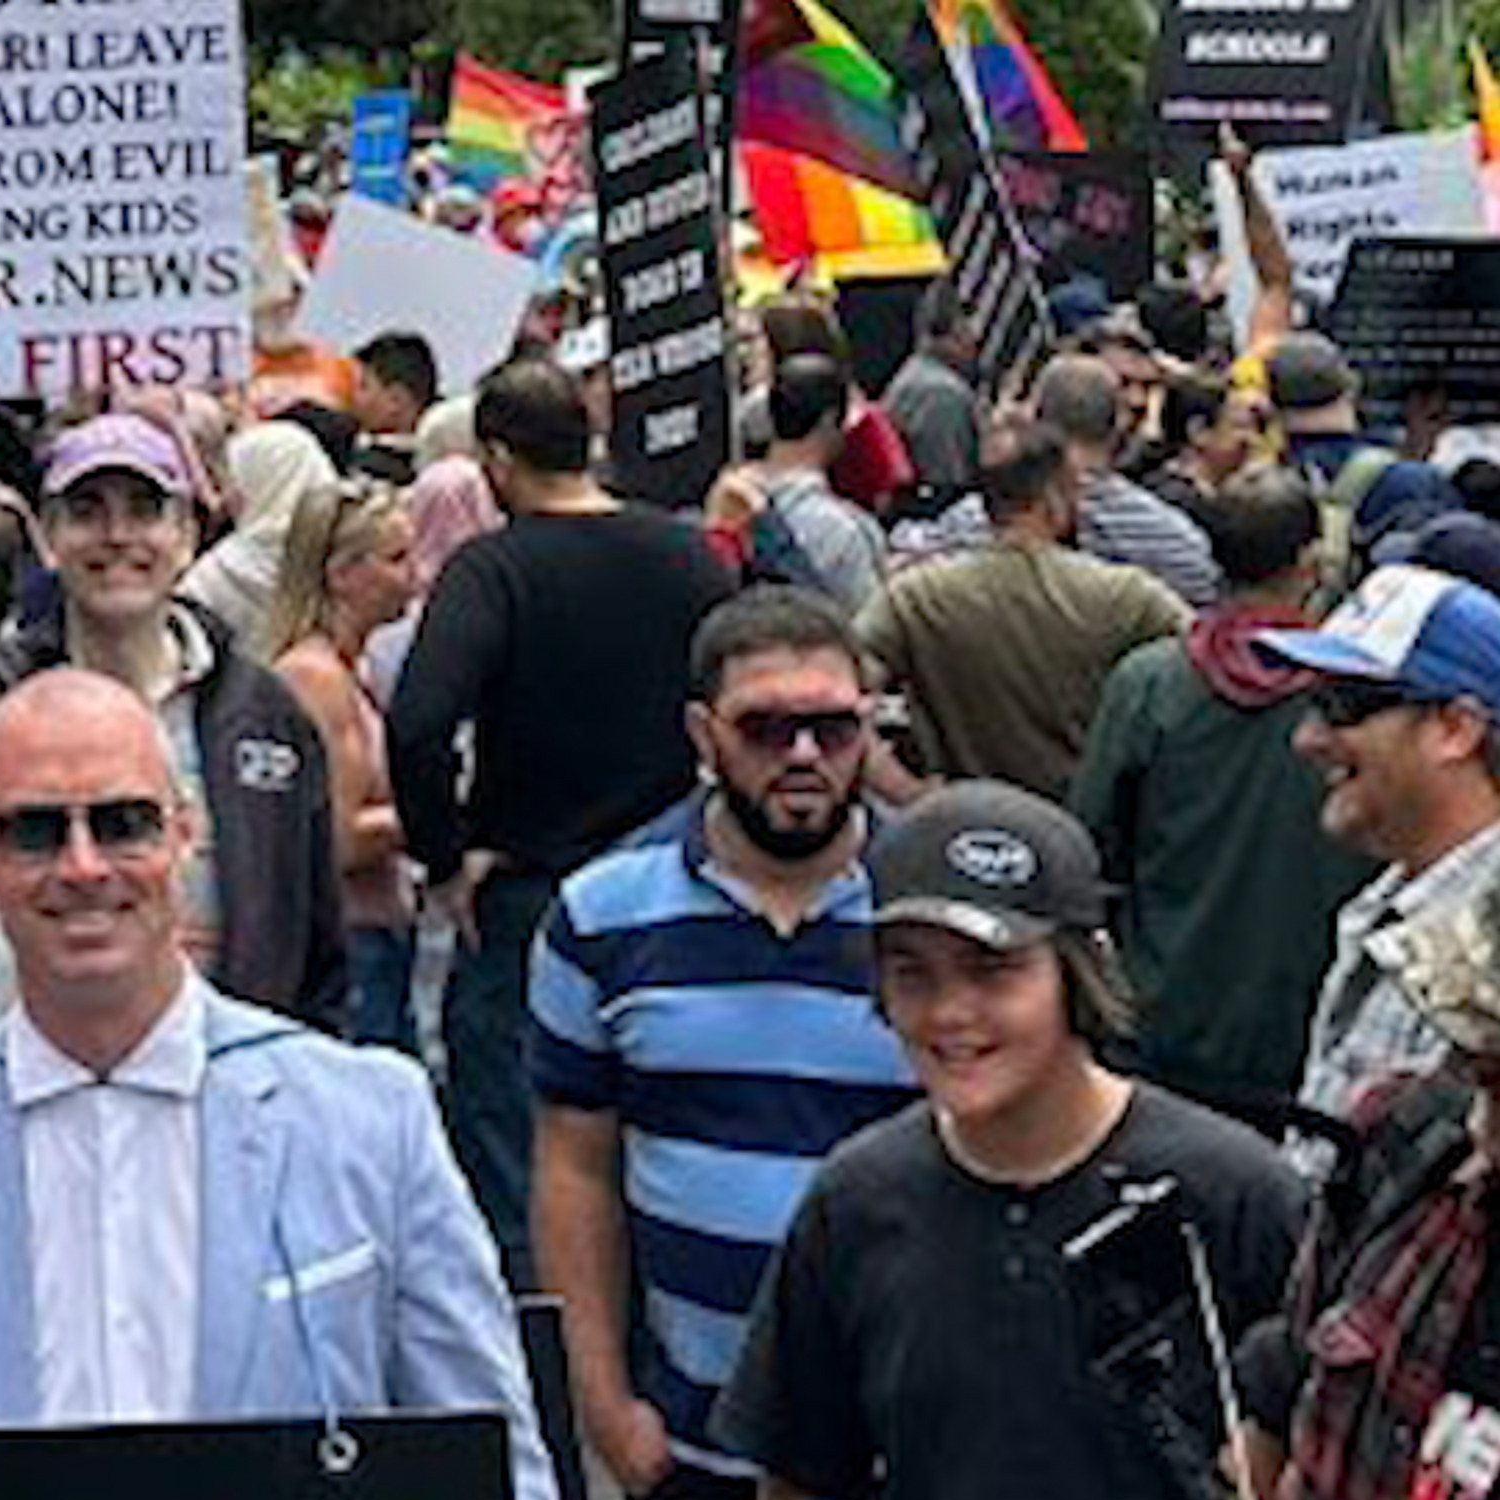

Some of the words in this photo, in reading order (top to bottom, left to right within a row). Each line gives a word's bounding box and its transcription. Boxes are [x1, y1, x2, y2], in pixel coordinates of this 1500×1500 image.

[65, 23, 230, 72] LEAVE
[112, 138, 231, 182] EVIL
[83, 194, 200, 242] KIDS
[18, 325, 240, 394] FIRST
